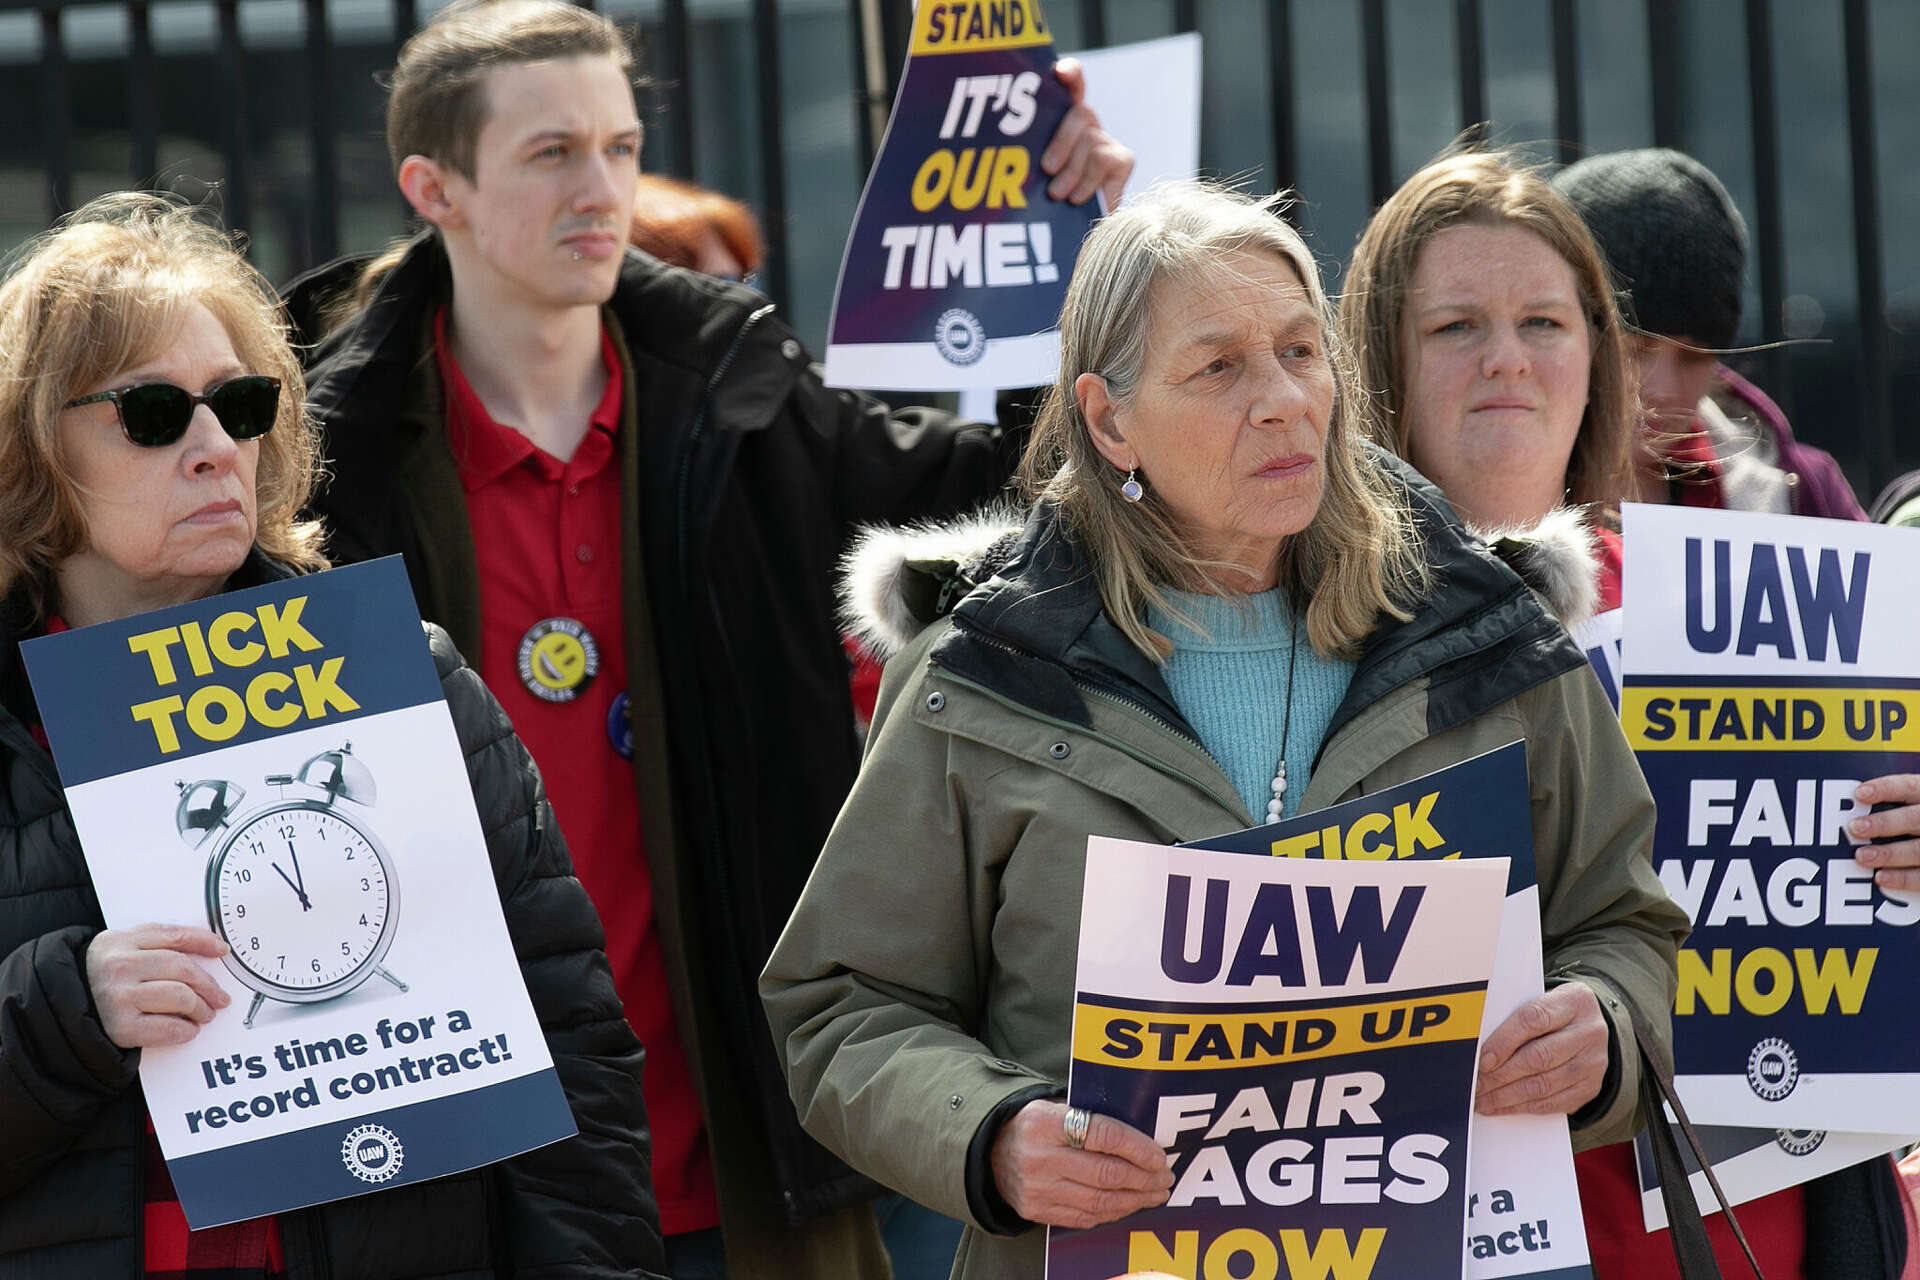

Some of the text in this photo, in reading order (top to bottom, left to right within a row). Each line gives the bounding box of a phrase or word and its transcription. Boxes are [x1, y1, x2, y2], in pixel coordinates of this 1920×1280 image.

[927, 0, 1024, 43] STAND
[939, 71, 1043, 139] IT'S
[911, 145, 1031, 213] OUR
[881, 222, 1060, 290] TIME!
[1685, 536, 1872, 665] UAW
[128, 596, 324, 686] TICK
[130, 656, 361, 754] TOCK
[1643, 698, 1908, 741] STAND UP
[278, 825, 296, 840] 12
[1687, 778, 1872, 846] FAIR
[250, 840, 265, 856] 11
[317, 828, 326, 840] 1
[344, 847, 355, 861] 2
[234, 869, 251, 884] 10
[360, 878, 370, 892] 3
[237, 904, 246, 918] 9
[359, 913, 368, 927] 4
[1160, 874, 1427, 988] UAW
[251, 937, 260, 951] 8
[277, 955, 286, 970] 7
[341, 942, 351, 956] 5
[311, 959, 321, 973] 6
[1675, 946, 1880, 1017] NOW
[201, 1009, 472, 1089] It's time for a
[1101, 1004, 1450, 1061] STAND UP
[185, 1033, 513, 1134] record contract!
[1154, 1071, 1386, 1148] FAIR
[359, 1144, 384, 1162] UAW
[1166, 1134, 1450, 1207] AGES
[1490, 1189, 1516, 1214] a
[1128, 1227, 1387, 1280] NOW
